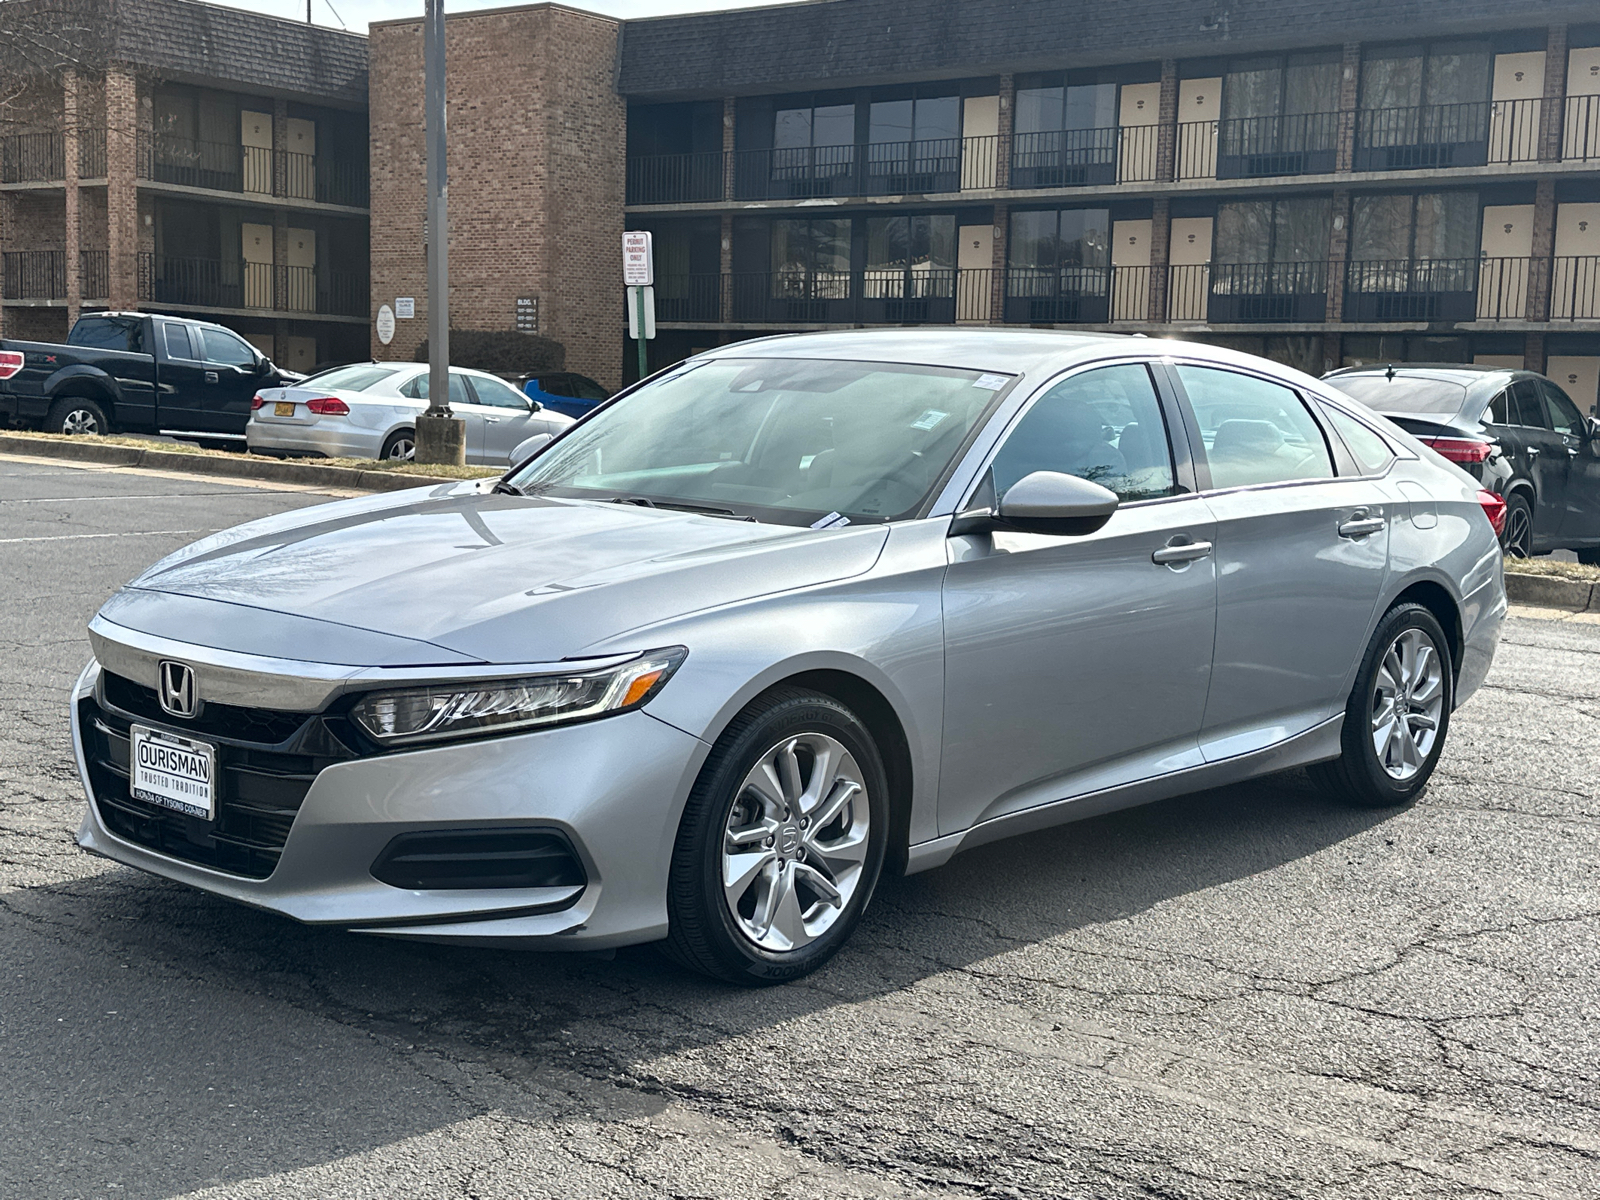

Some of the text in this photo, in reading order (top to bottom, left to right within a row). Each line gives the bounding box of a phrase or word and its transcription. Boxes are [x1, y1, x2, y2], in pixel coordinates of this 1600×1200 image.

[140, 744, 207, 779] OURISMAN
[141, 770, 168, 788] TRUSTED
[172, 779, 208, 798] TRADITION
[136, 789, 154, 802] HONDA
[164, 797, 184, 811] TYSONS
[185, 803, 207, 818] CORNER
